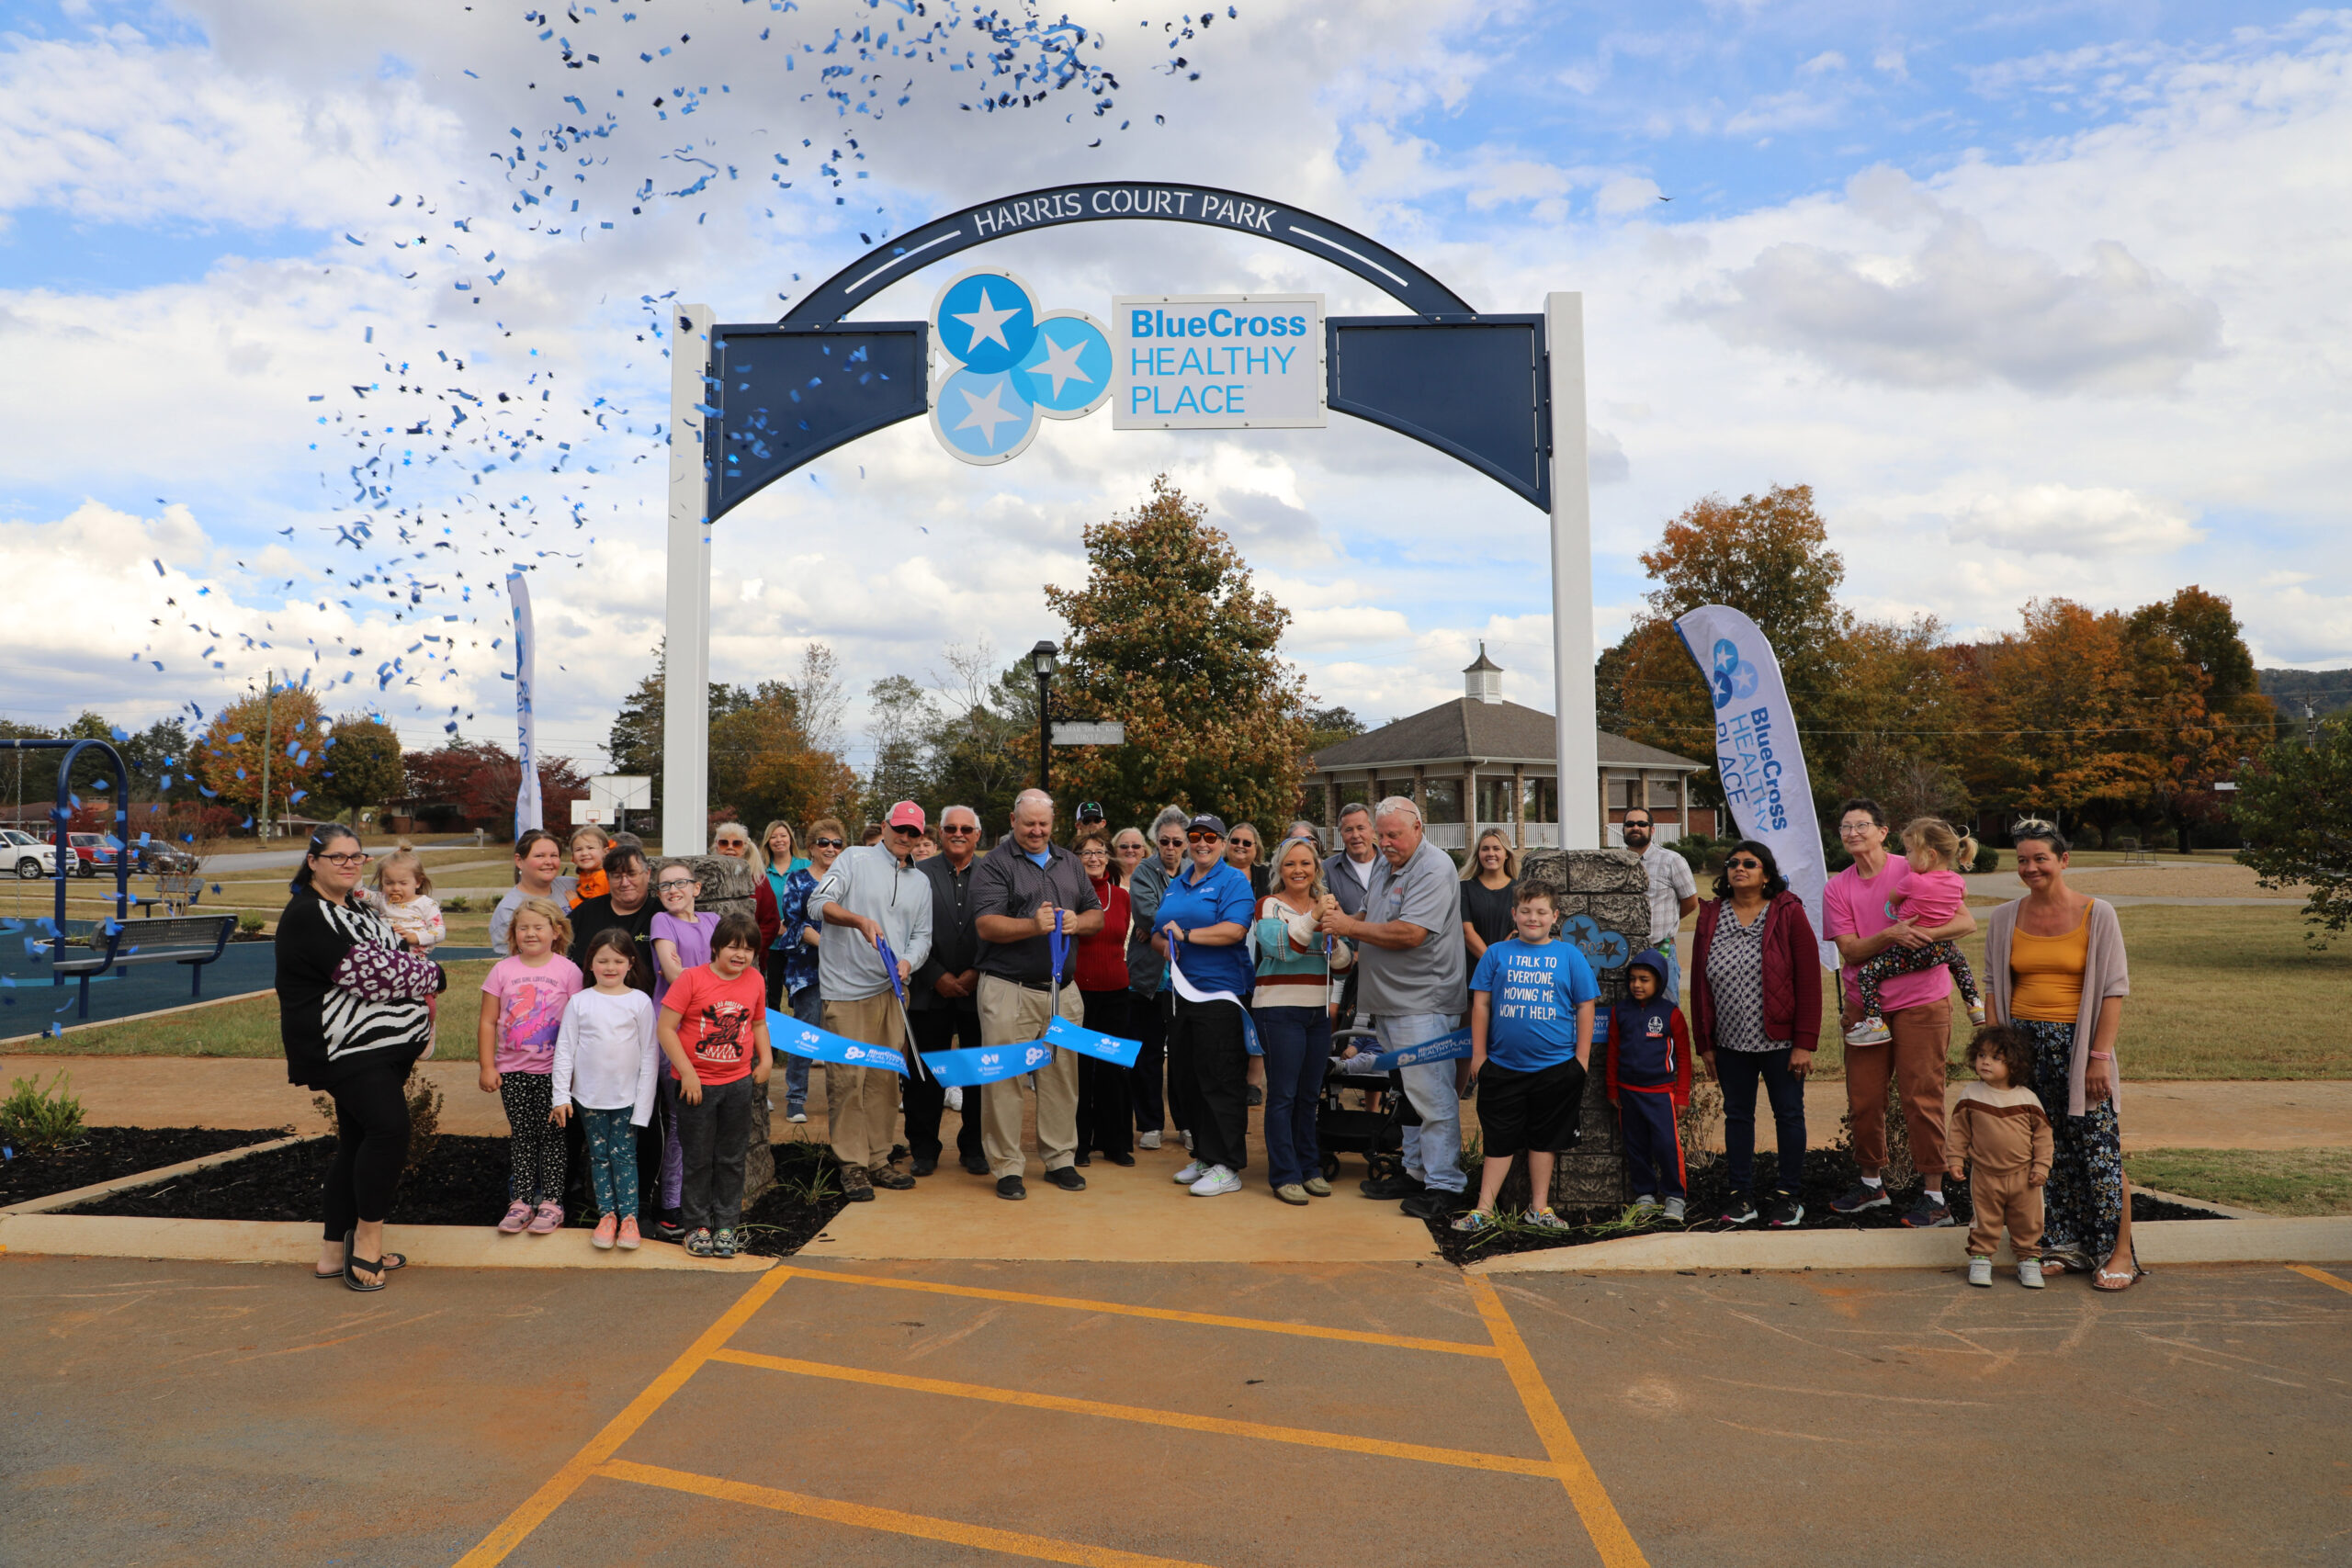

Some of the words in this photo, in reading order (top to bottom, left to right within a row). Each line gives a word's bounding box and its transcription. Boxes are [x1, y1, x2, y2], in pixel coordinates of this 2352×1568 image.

[974, 193, 1082, 236] HARRIS
[1091, 189, 1193, 215] COURT
[1201, 195, 1277, 232] PARK
[1131, 309, 1306, 337] BlueCross
[1132, 346, 1296, 376] HEALTHY
[1132, 385, 1245, 414] PLACE
[1105, 725, 1123, 733] KING
[1729, 714, 1769, 832] HEALTHY
[1750, 706, 1787, 830] BlueCross
[1509, 955, 1513, 965] I
[1516, 955, 1541, 967] TALK
[1544, 956, 1557, 968] TO
[1508, 969, 1555, 987] EVERYONE,
[713, 1000, 724, 1009] LOS
[1503, 987, 1539, 1002] MOVING
[1542, 990, 1555, 1003] ME
[1499, 1004, 1526, 1019] WON'T
[1530, 1005, 1556, 1021] HELP!
